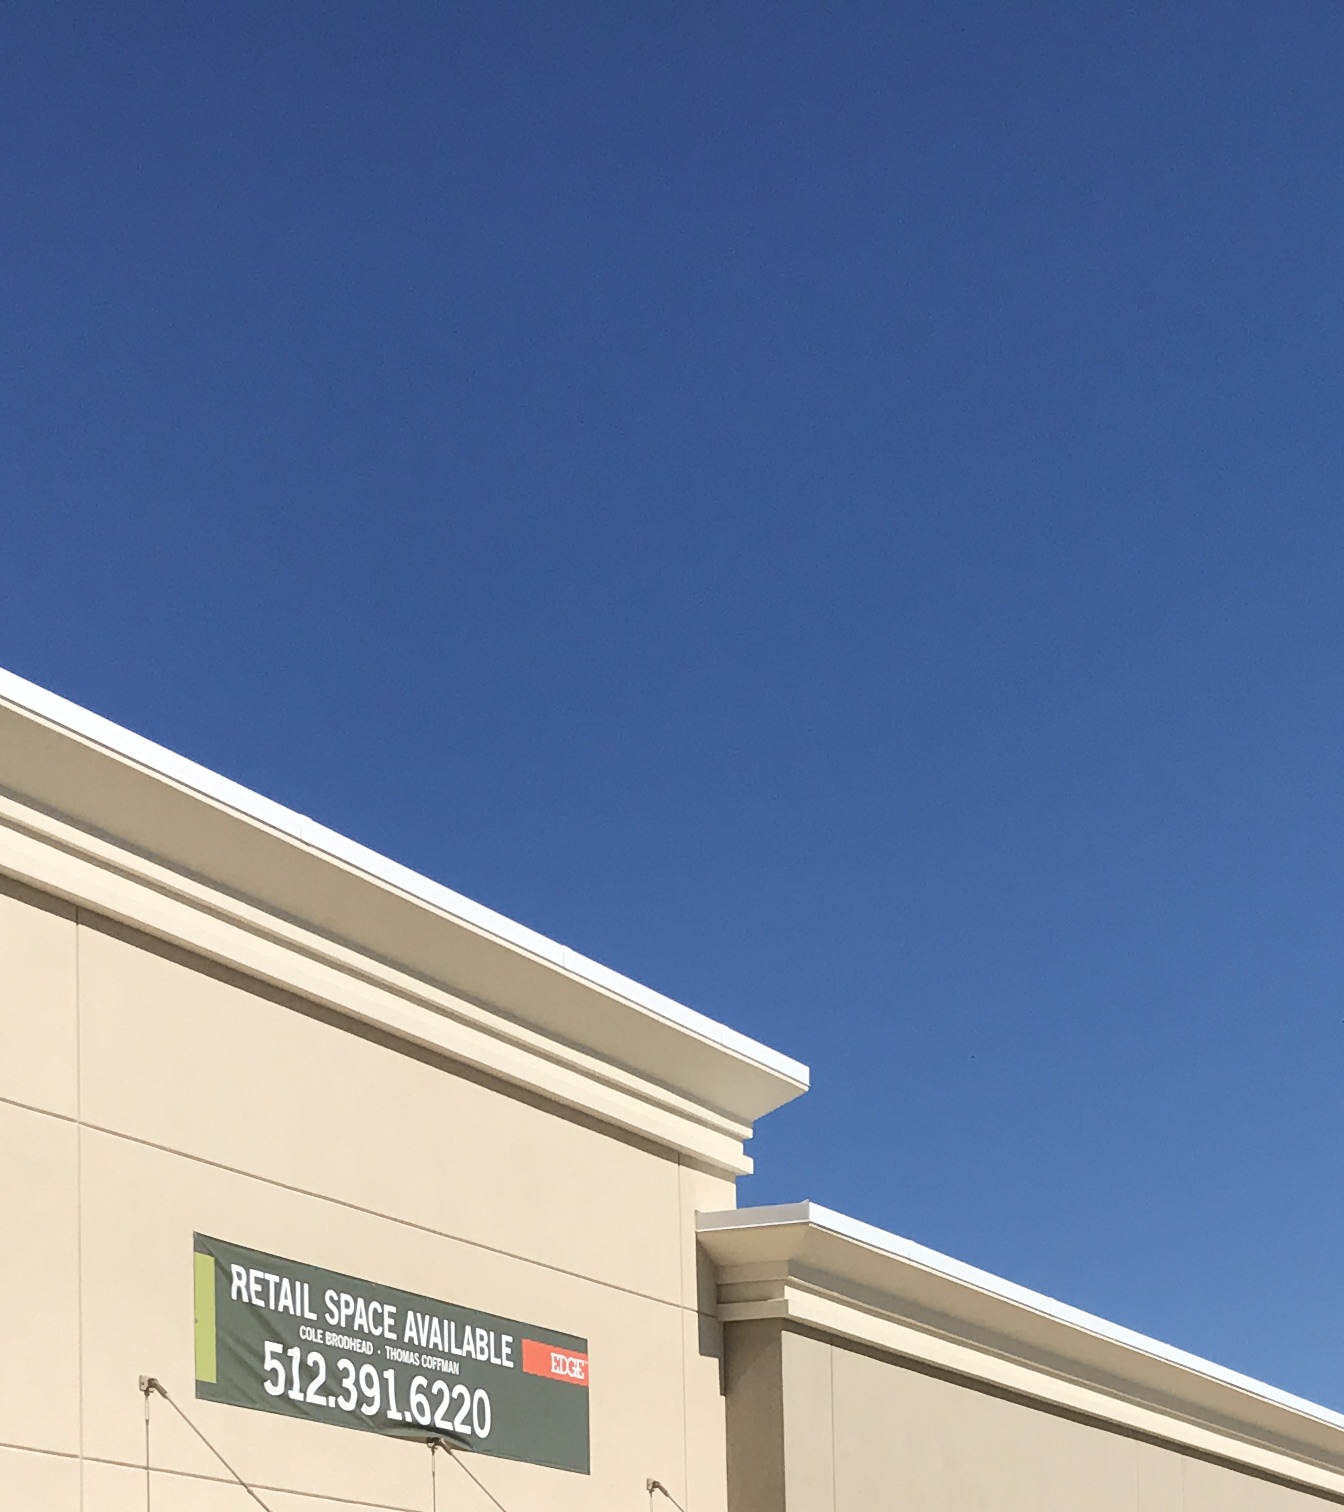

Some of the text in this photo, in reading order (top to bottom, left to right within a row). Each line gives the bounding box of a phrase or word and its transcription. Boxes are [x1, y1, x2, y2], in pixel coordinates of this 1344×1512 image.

[230, 1263, 515, 1369] RETAIL SPACE AVAILABLE
[299, 1325, 460, 1376] COLE BRODHEAD THOMAS COFFMAN
[262, 1340, 492, 1439] 512.391.6220
[550, 1351, 585, 1380] EDGE
